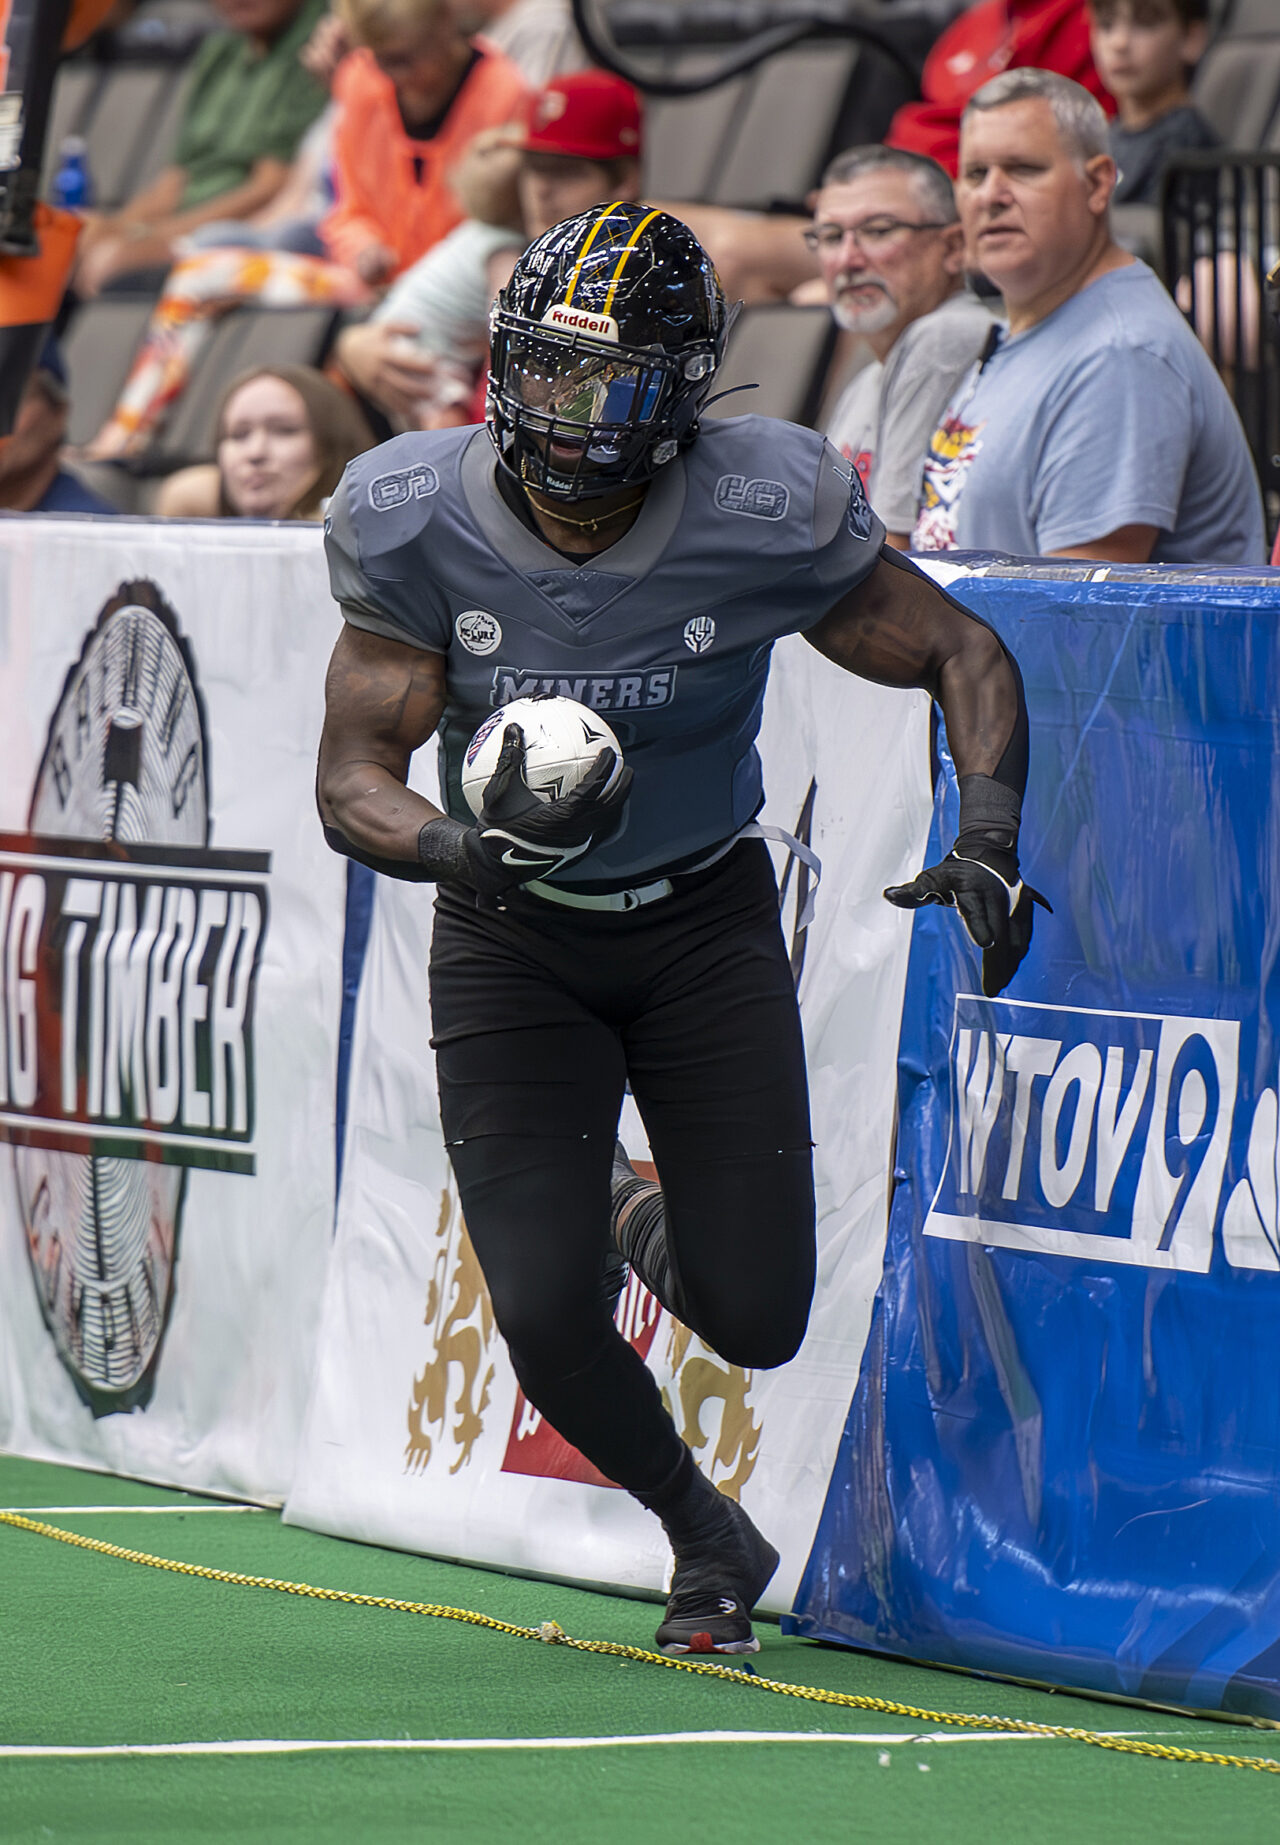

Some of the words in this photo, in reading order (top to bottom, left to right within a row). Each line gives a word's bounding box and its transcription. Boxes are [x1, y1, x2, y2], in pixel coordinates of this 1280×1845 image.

[552, 310, 610, 335] Riddell
[546, 475, 574, 490] Riddel
[495, 671, 673, 710] MINERS
[61, 877, 262, 1133] TIMBER
[956, 1028, 1220, 1253] WTOV9
